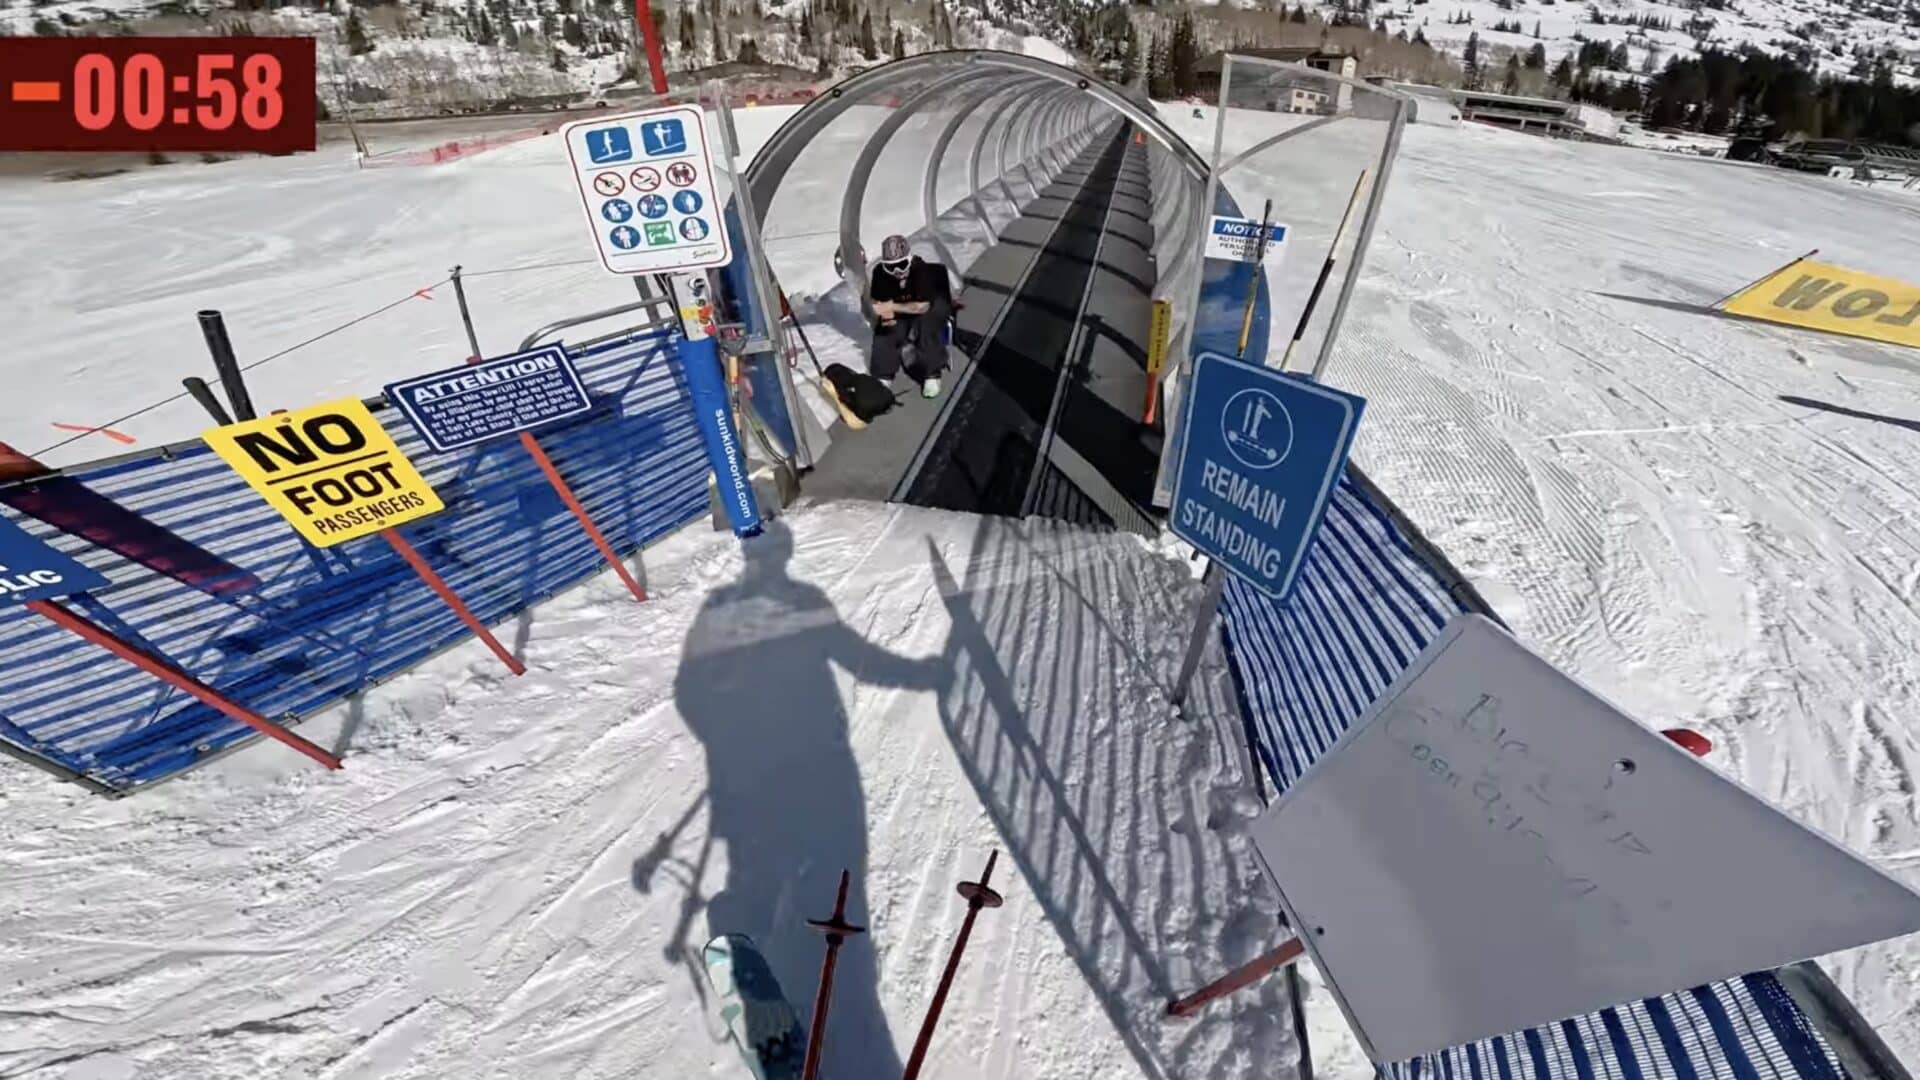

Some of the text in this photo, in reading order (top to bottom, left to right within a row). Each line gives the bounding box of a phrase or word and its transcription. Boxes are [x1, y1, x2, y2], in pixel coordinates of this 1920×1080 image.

[414, 355, 557, 403] ATTENTION
[233, 413, 367, 473] NO
[715, 408, 752, 519] sunkidworld.com
[282, 461, 402, 516] FOOT
[312, 491, 425, 535] PASSENGERS
[1200, 458, 1286, 530] REMAIN
[1182, 498, 1281, 580] STANDING
[0, 569, 63, 594] LIC
